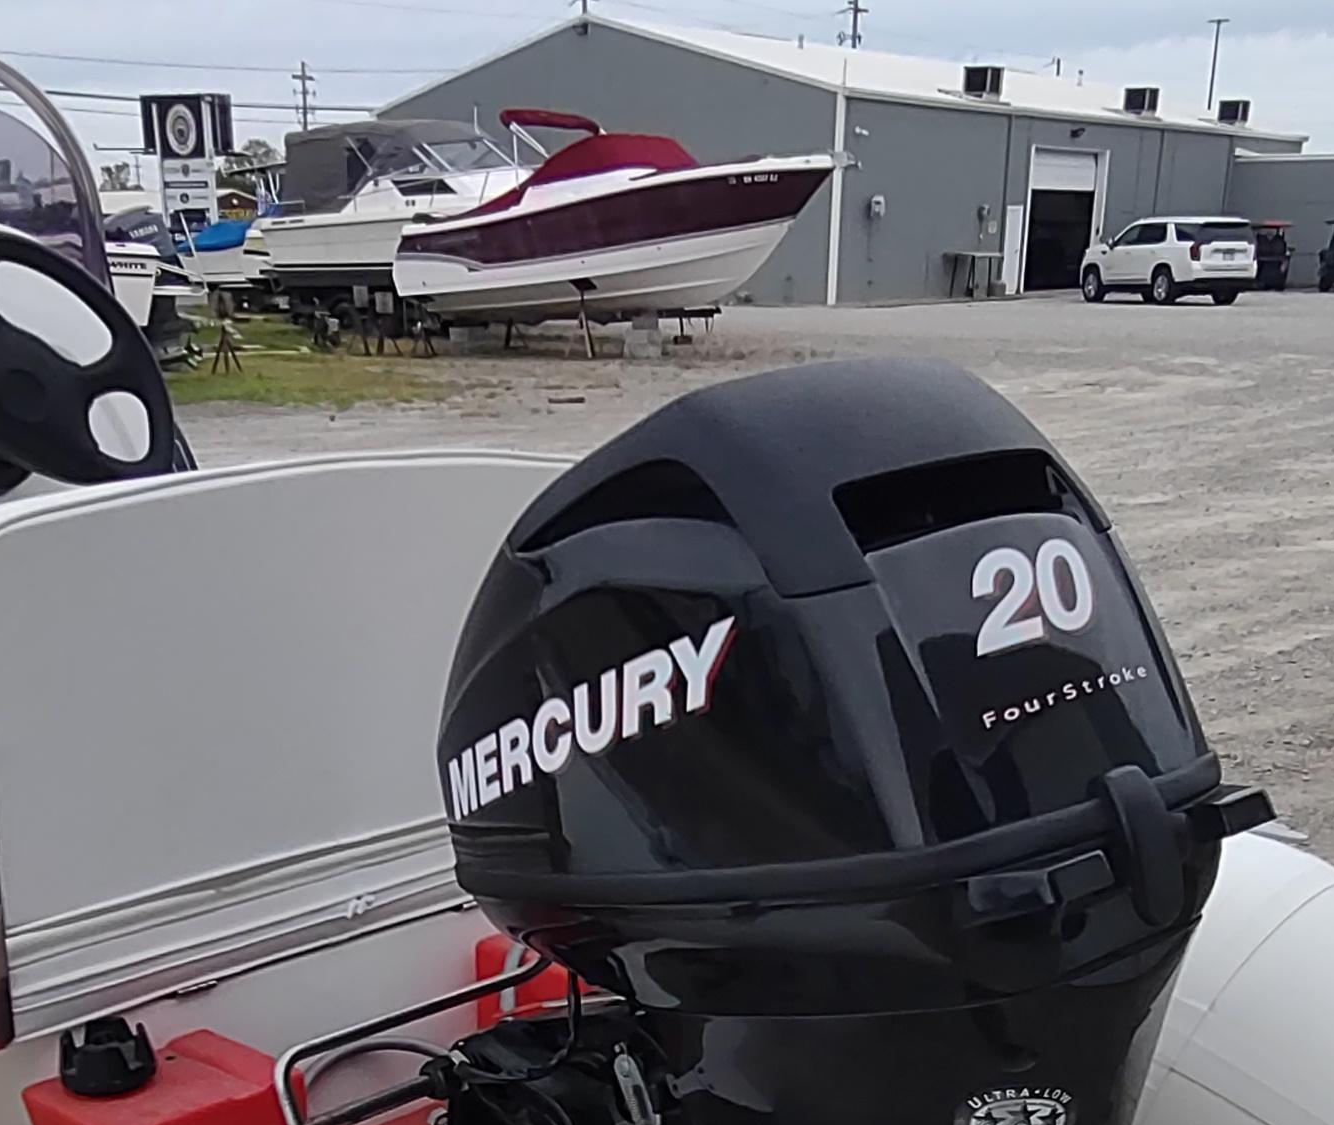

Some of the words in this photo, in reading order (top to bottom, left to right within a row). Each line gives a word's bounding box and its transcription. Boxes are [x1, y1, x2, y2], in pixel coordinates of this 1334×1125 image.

[972, 538, 1093, 657] 20
[448, 616, 735, 821] MERCURY
[982, 665, 1147, 729] FourStroke
